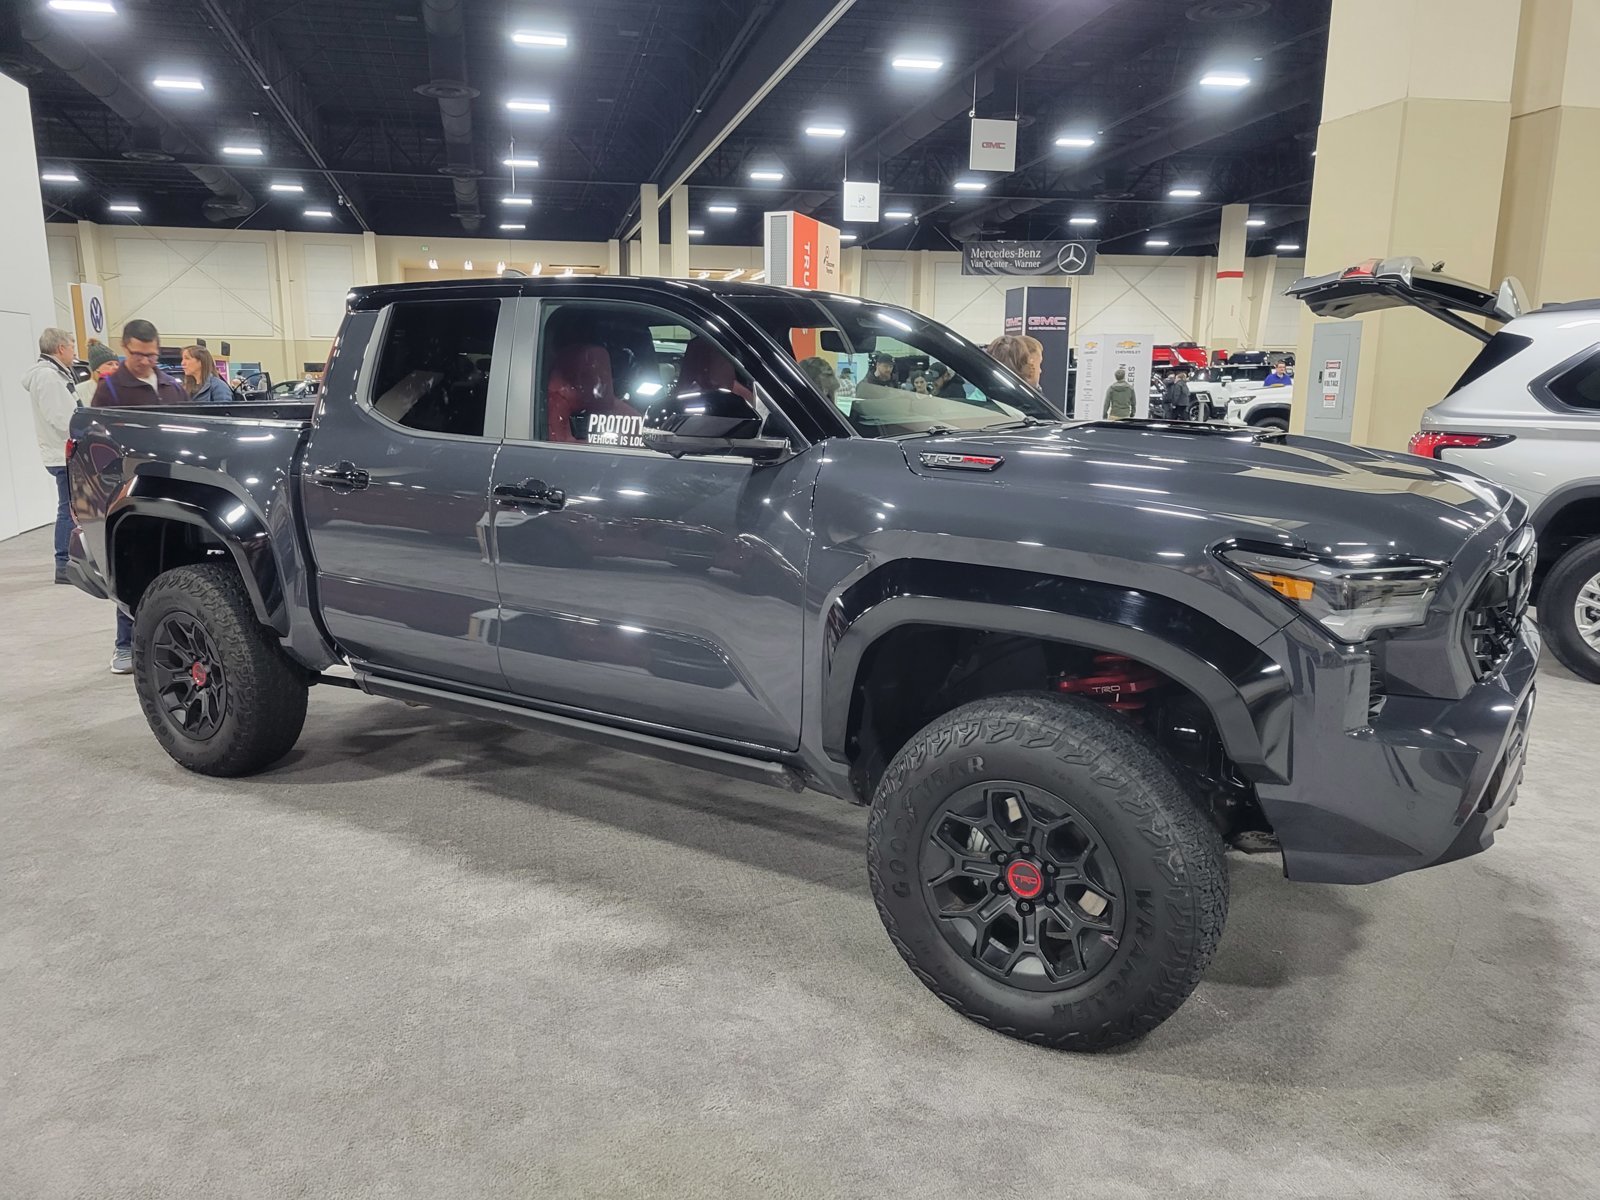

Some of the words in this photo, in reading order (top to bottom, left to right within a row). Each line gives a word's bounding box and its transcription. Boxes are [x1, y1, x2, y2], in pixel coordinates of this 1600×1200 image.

[981, 141, 1006, 150] GMC
[970, 247, 1042, 259] Mercedes-Benz
[970, 260, 984, 269] Van
[985, 260, 1009, 269] Center
[1014, 260, 1042, 269] Warner
[1028, 316, 1067, 326] GMC
[588, 433, 618, 445] VEHICLE
[619, 435, 629, 446] IS
[922, 452, 964, 465] TRD
[1091, 684, 1121, 694] TRD
[1012, 873, 1038, 885] TRD
